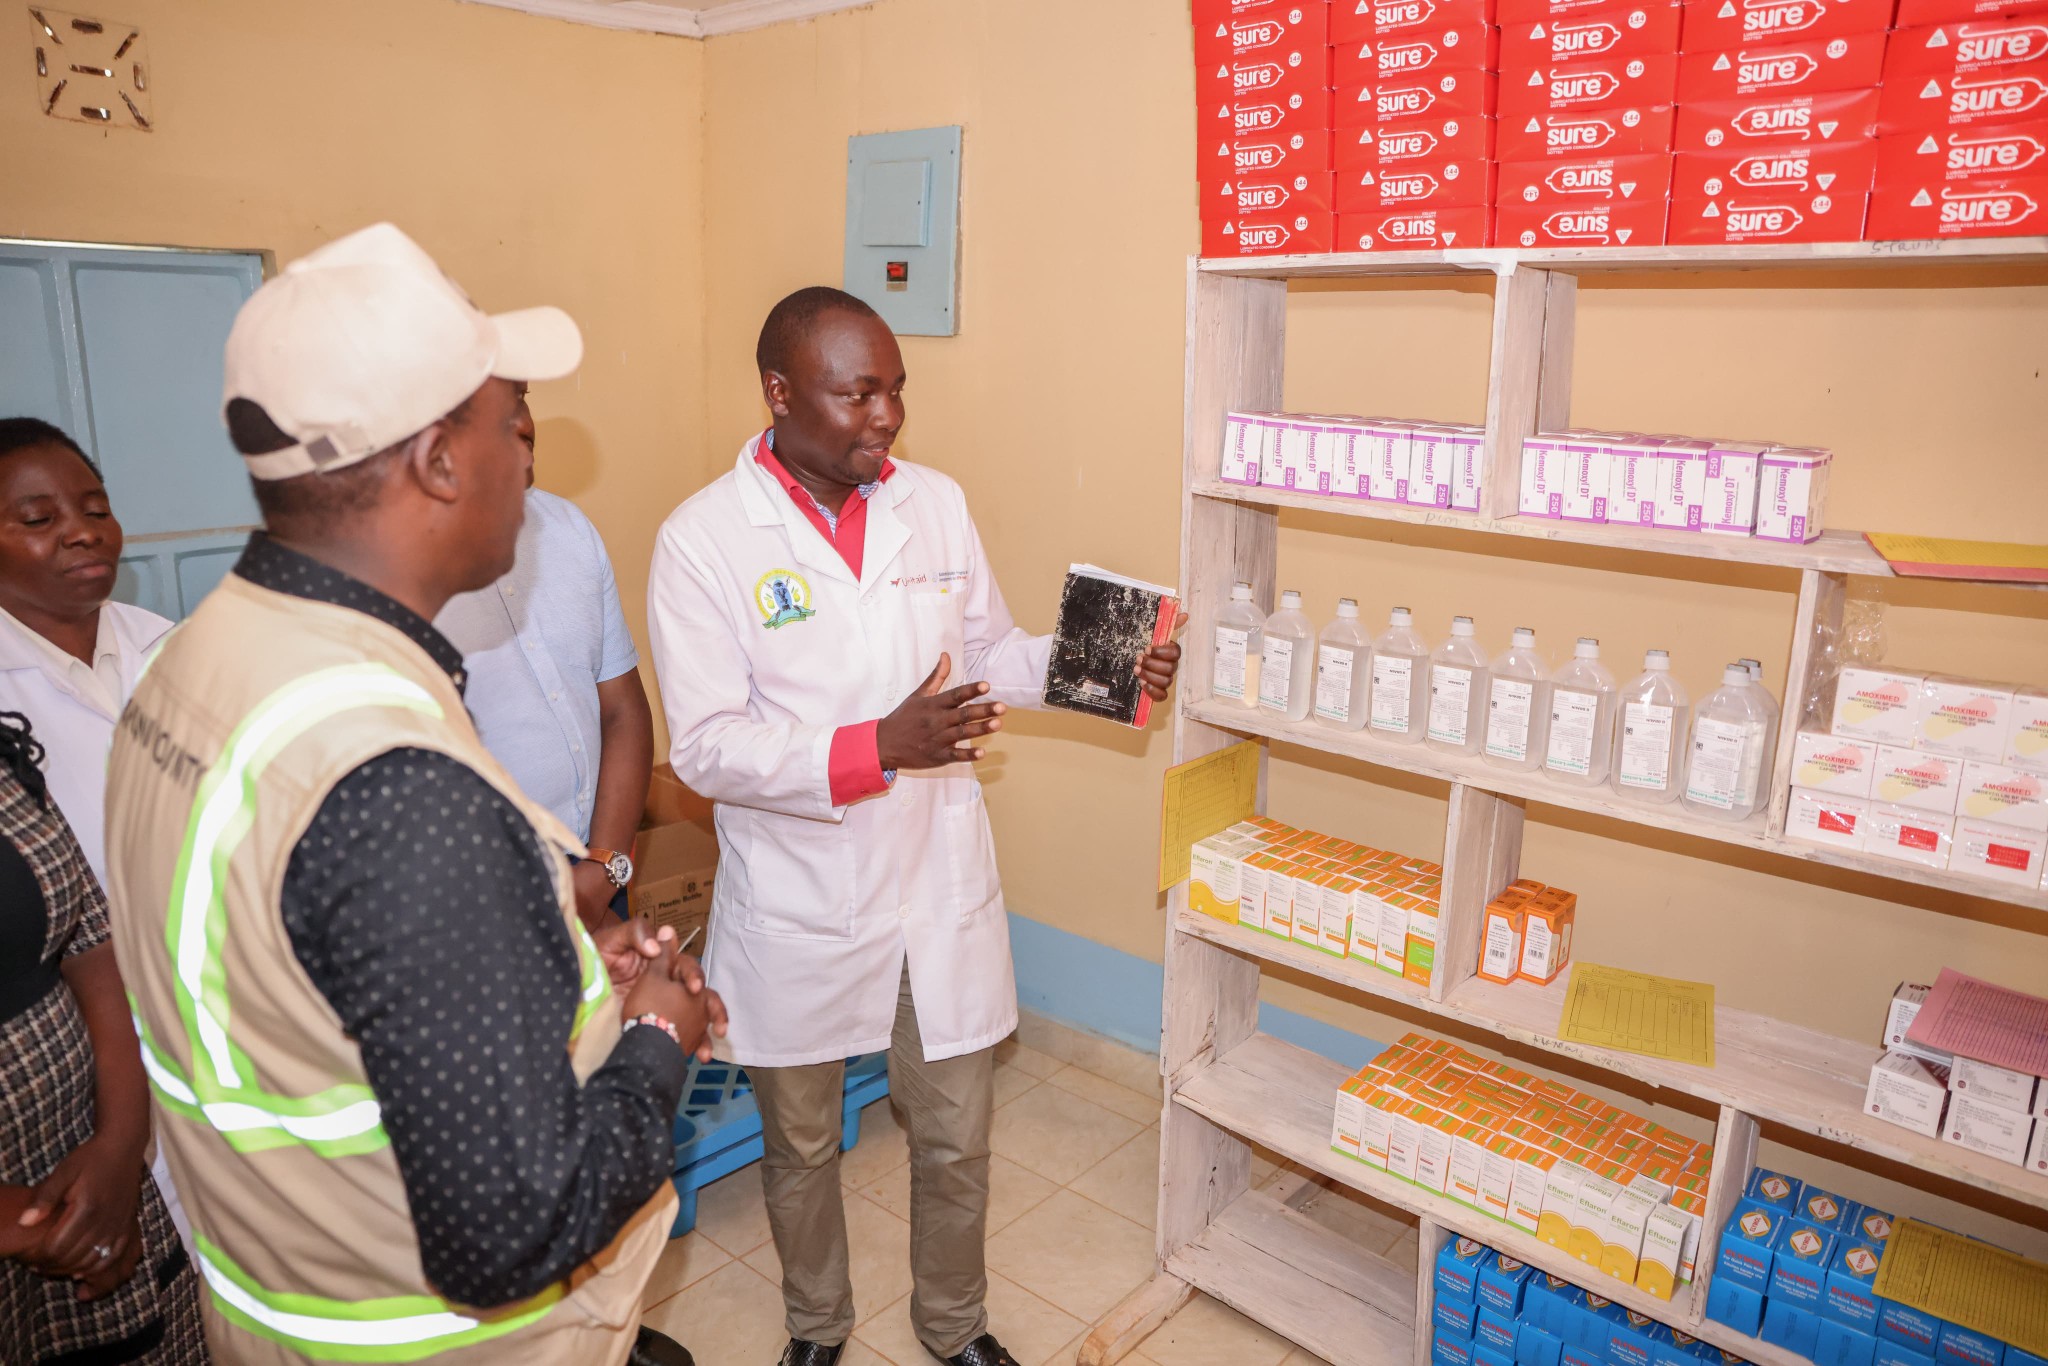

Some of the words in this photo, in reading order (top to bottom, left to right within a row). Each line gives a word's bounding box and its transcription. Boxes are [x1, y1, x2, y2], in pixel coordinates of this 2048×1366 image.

[1375, 4, 1419, 24] sure
[1744, 5, 1803, 31] sure
[1233, 28, 1270, 46] sure
[1552, 30, 1602, 51] sure
[1957, 34, 2030, 61] sure
[1378, 49, 1421, 69] sure
[1234, 70, 1270, 87] sure
[1738, 60, 1796, 83] sure
[1551, 78, 1601, 98] sure
[1377, 93, 1419, 112] sure
[1951, 86, 2022, 112] sure
[1235, 111, 1271, 128] sure
[1752, 107, 1811, 128] sure
[1547, 127, 1597, 145] sure
[1379, 137, 1422, 155] sure
[1235, 150, 1272, 166] sure
[1947, 144, 2018, 168] sure
[1750, 159, 1808, 179] sure
[1562, 169, 1612, 187] sure
[1380, 180, 1423, 197] sure
[1238, 190, 1275, 206] sure
[1941, 200, 2011, 222] sure
[1393, 220, 1435, 236] sure
[1559, 215, 1609, 232] sure
[1727, 212, 1782, 231] sure
[1240, 230, 1276, 245] sure
[1237, 424, 1247, 453] Kemoxyl
[1275, 429, 1283, 459] Kemoxyl
[1309, 433, 1318, 462] Kemoxyl
[1347, 435, 1356, 465] Kemoxyl
[1385, 439, 1394, 469] Kemoxyl
[1237, 453, 1244, 463] DT
[1275, 458, 1282, 469] DT
[1425, 442, 1436, 474] Kemoxyl
[1466, 445, 1475, 478] Kemoxyl
[1537, 450, 1548, 483] Kemoxyl
[1309, 463, 1316, 473] DT
[1348, 466, 1355, 476] DT
[1580, 453, 1592, 487] Kemoxyl
[1626, 457, 1638, 492] Kemoxyl
[1709, 458, 1718, 476] 250
[1385, 471, 1393, 481] DT
[1425, 475, 1433, 486] DT
[1466, 478, 1474, 489] DT
[1674, 460, 1686, 495] Kemoxyl
[1725, 477, 1735, 488] DT
[1398, 481, 1406, 498] 250
[1537, 484, 1546, 495] DT
[1580, 487, 1589, 499] DT
[1777, 468, 1791, 507] Kemoxyl
[1551, 495, 1559, 513] 250
[1626, 492, 1636, 503] DT
[1674, 495, 1683, 507] DT
[1595, 500, 1604, 517] 250
[1642, 503, 1651, 521] 250
[1690, 507, 1699, 525] 250
[1722, 490, 1733, 525] Kemoxyl
[1776, 506, 1787, 517] DT
[1793, 518, 1802, 538] 250
[1856, 690, 1900, 703] AMOXIMED
[1940, 704, 1987, 718] AMOXIMED
[1813, 753, 1855, 766] AMOXIMED
[1894, 767, 1940, 780] AMOXIMED
[1982, 783, 2031, 797] AMOXIMED
[1355, 931, 1376, 943] Eflaron
[1411, 925, 1435, 939] Eflaron
[1381, 943, 1403, 955] Eflaron
[1483, 1187, 1506, 1202] Eflaron
[1547, 1183, 1574, 1200] Eflaron
[1514, 1200, 1538, 1215] Eflaron
[1579, 1198, 1607, 1215] Eflaron
[1611, 1215, 1640, 1232] Eflaron
[1648, 1229, 1677, 1246] Eflaron
